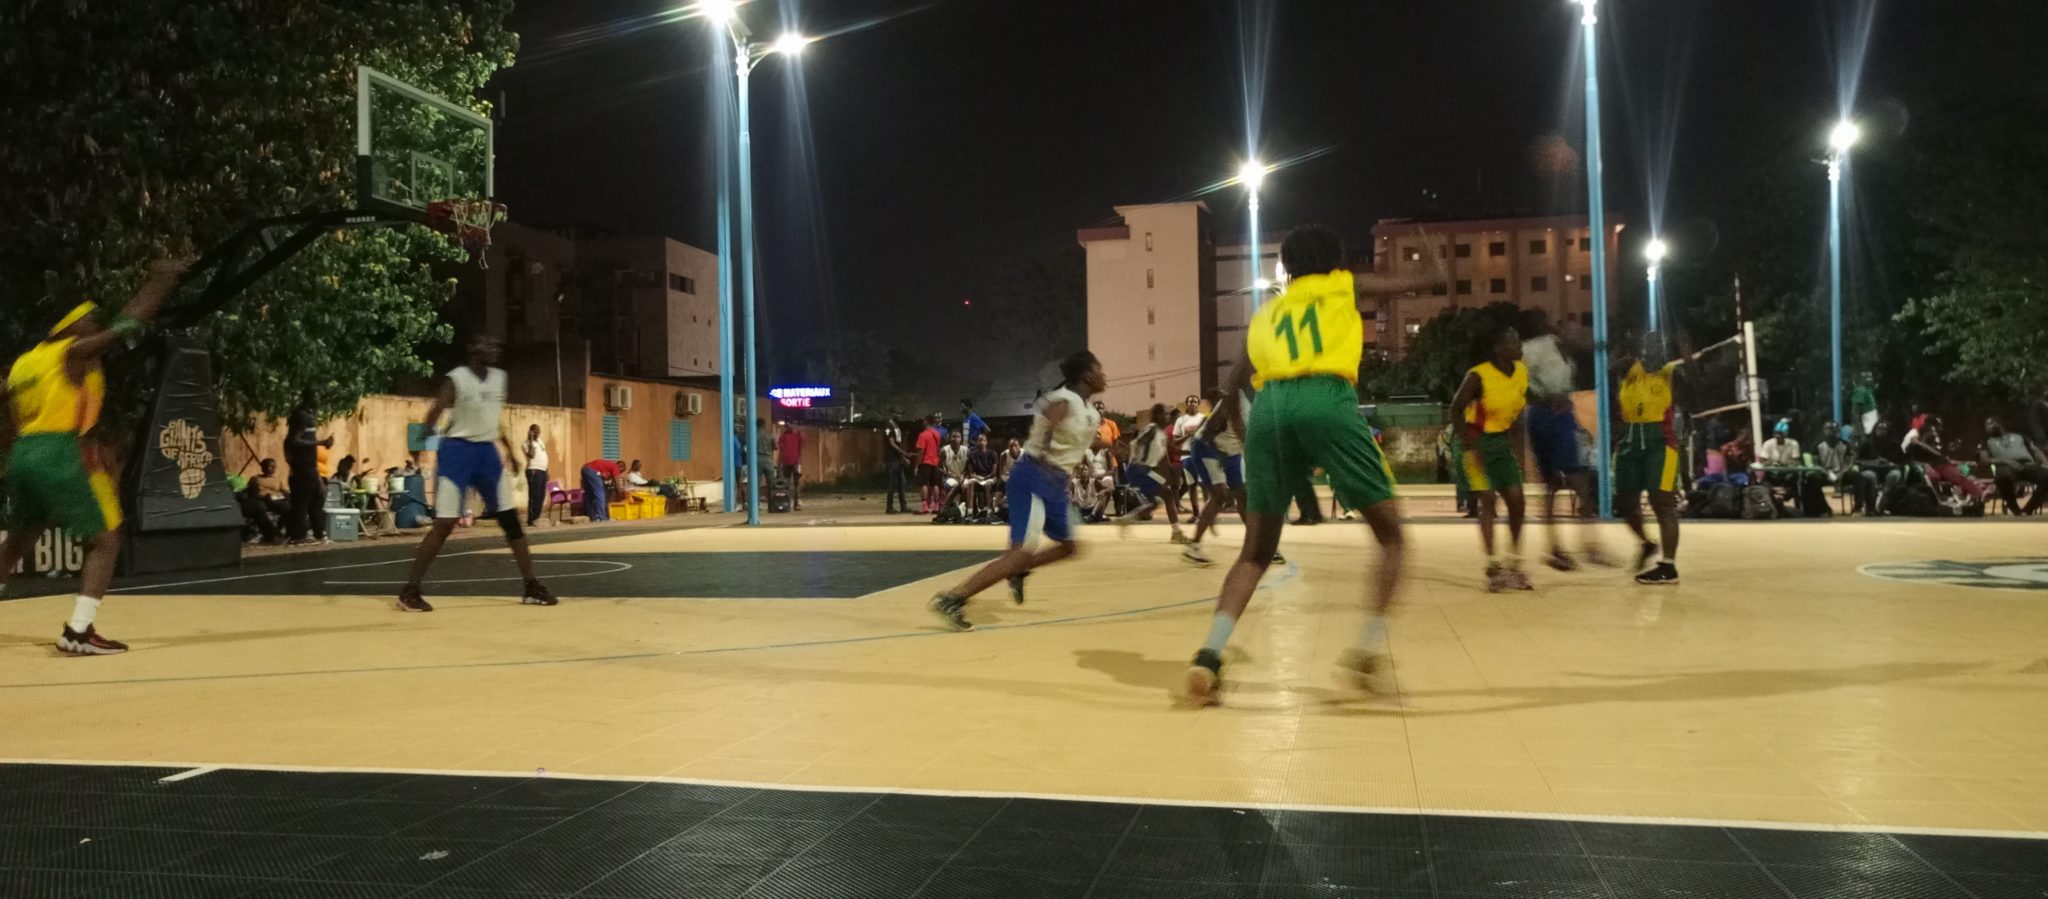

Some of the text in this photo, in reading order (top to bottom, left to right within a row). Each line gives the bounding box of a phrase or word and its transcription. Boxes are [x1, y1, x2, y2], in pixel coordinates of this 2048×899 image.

[1275, 303, 1323, 360] 11
[780, 398, 811, 407] SORTIE
[783, 387, 831, 397] MATERIAUX
[160, 419, 206, 453] GIANTS
[161, 448, 213, 469] OF AFRICA
[35, 527, 83, 571] BIG
